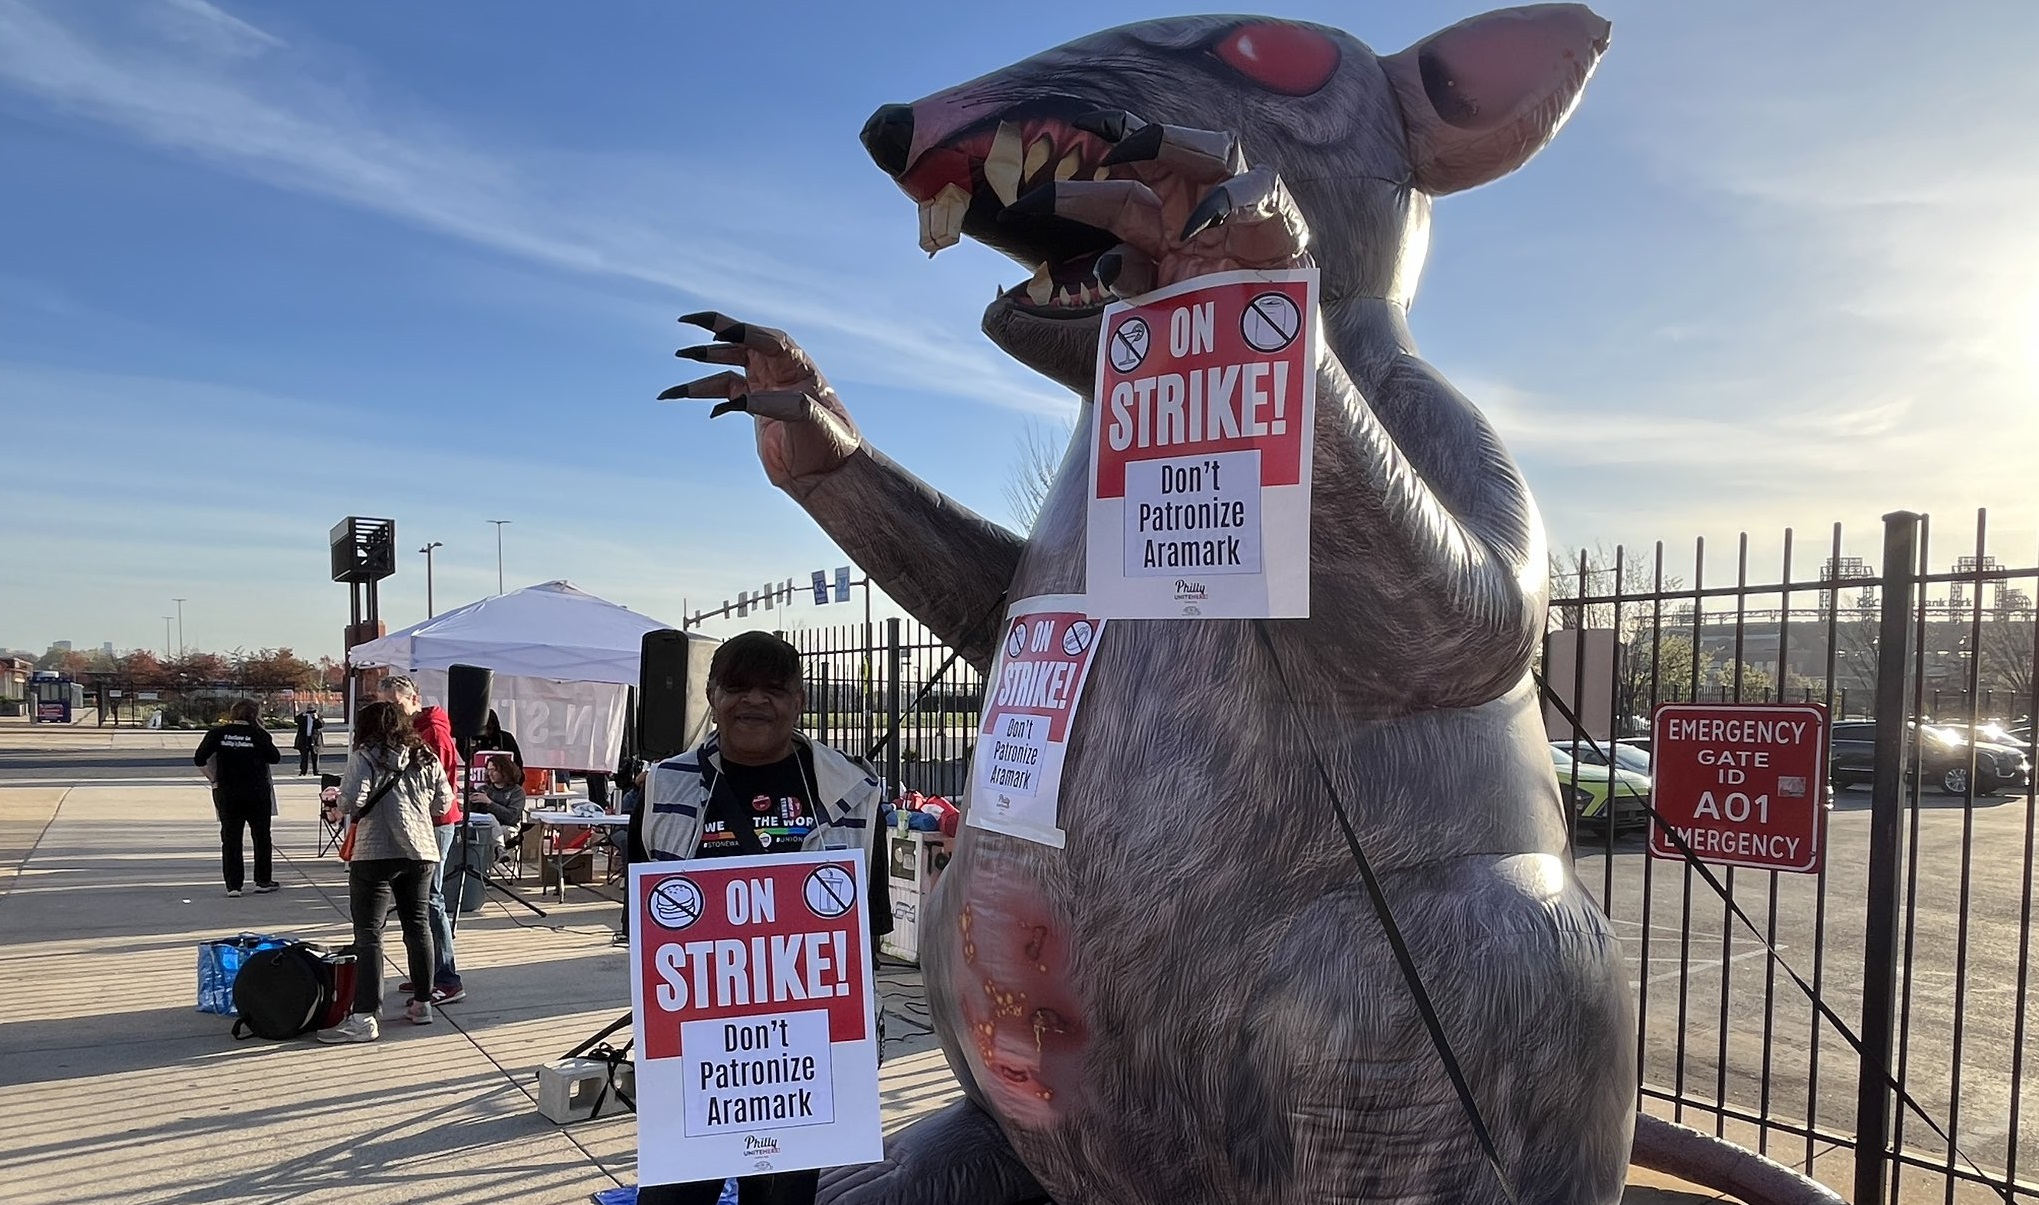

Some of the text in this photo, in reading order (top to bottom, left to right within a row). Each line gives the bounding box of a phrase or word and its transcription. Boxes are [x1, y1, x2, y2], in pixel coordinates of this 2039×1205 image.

[1170, 301, 1215, 358] ON
[1108, 361, 1289, 452] STRIKE!
[1161, 461, 1220, 495] Don't
[1139, 497, 1245, 532] Patronize
[1143, 535, 1241, 568] Aramark
[1175, 579, 1205, 595] Philly
[1031, 620, 1055, 652] ON
[998, 661, 1077, 710] STRIKE!
[1006, 718, 1033, 739] Don't
[1669, 718, 1806, 744] EMERGENCY
[993, 741, 1038, 766] Patronize
[1697, 750, 1769, 768] GATE
[990, 765, 1031, 790] Aramark
[1718, 769, 1745, 784] ID
[704, 821, 725, 832] WE
[752, 816, 778, 827] THE
[725, 877, 776, 925] ON
[655, 930, 850, 1012] STRIKE!
[723, 1019, 789, 1053] Don't
[700, 1053, 815, 1091] Patronize
[707, 1088, 813, 1126] Aramark
[744, 1135, 778, 1149] Philly
